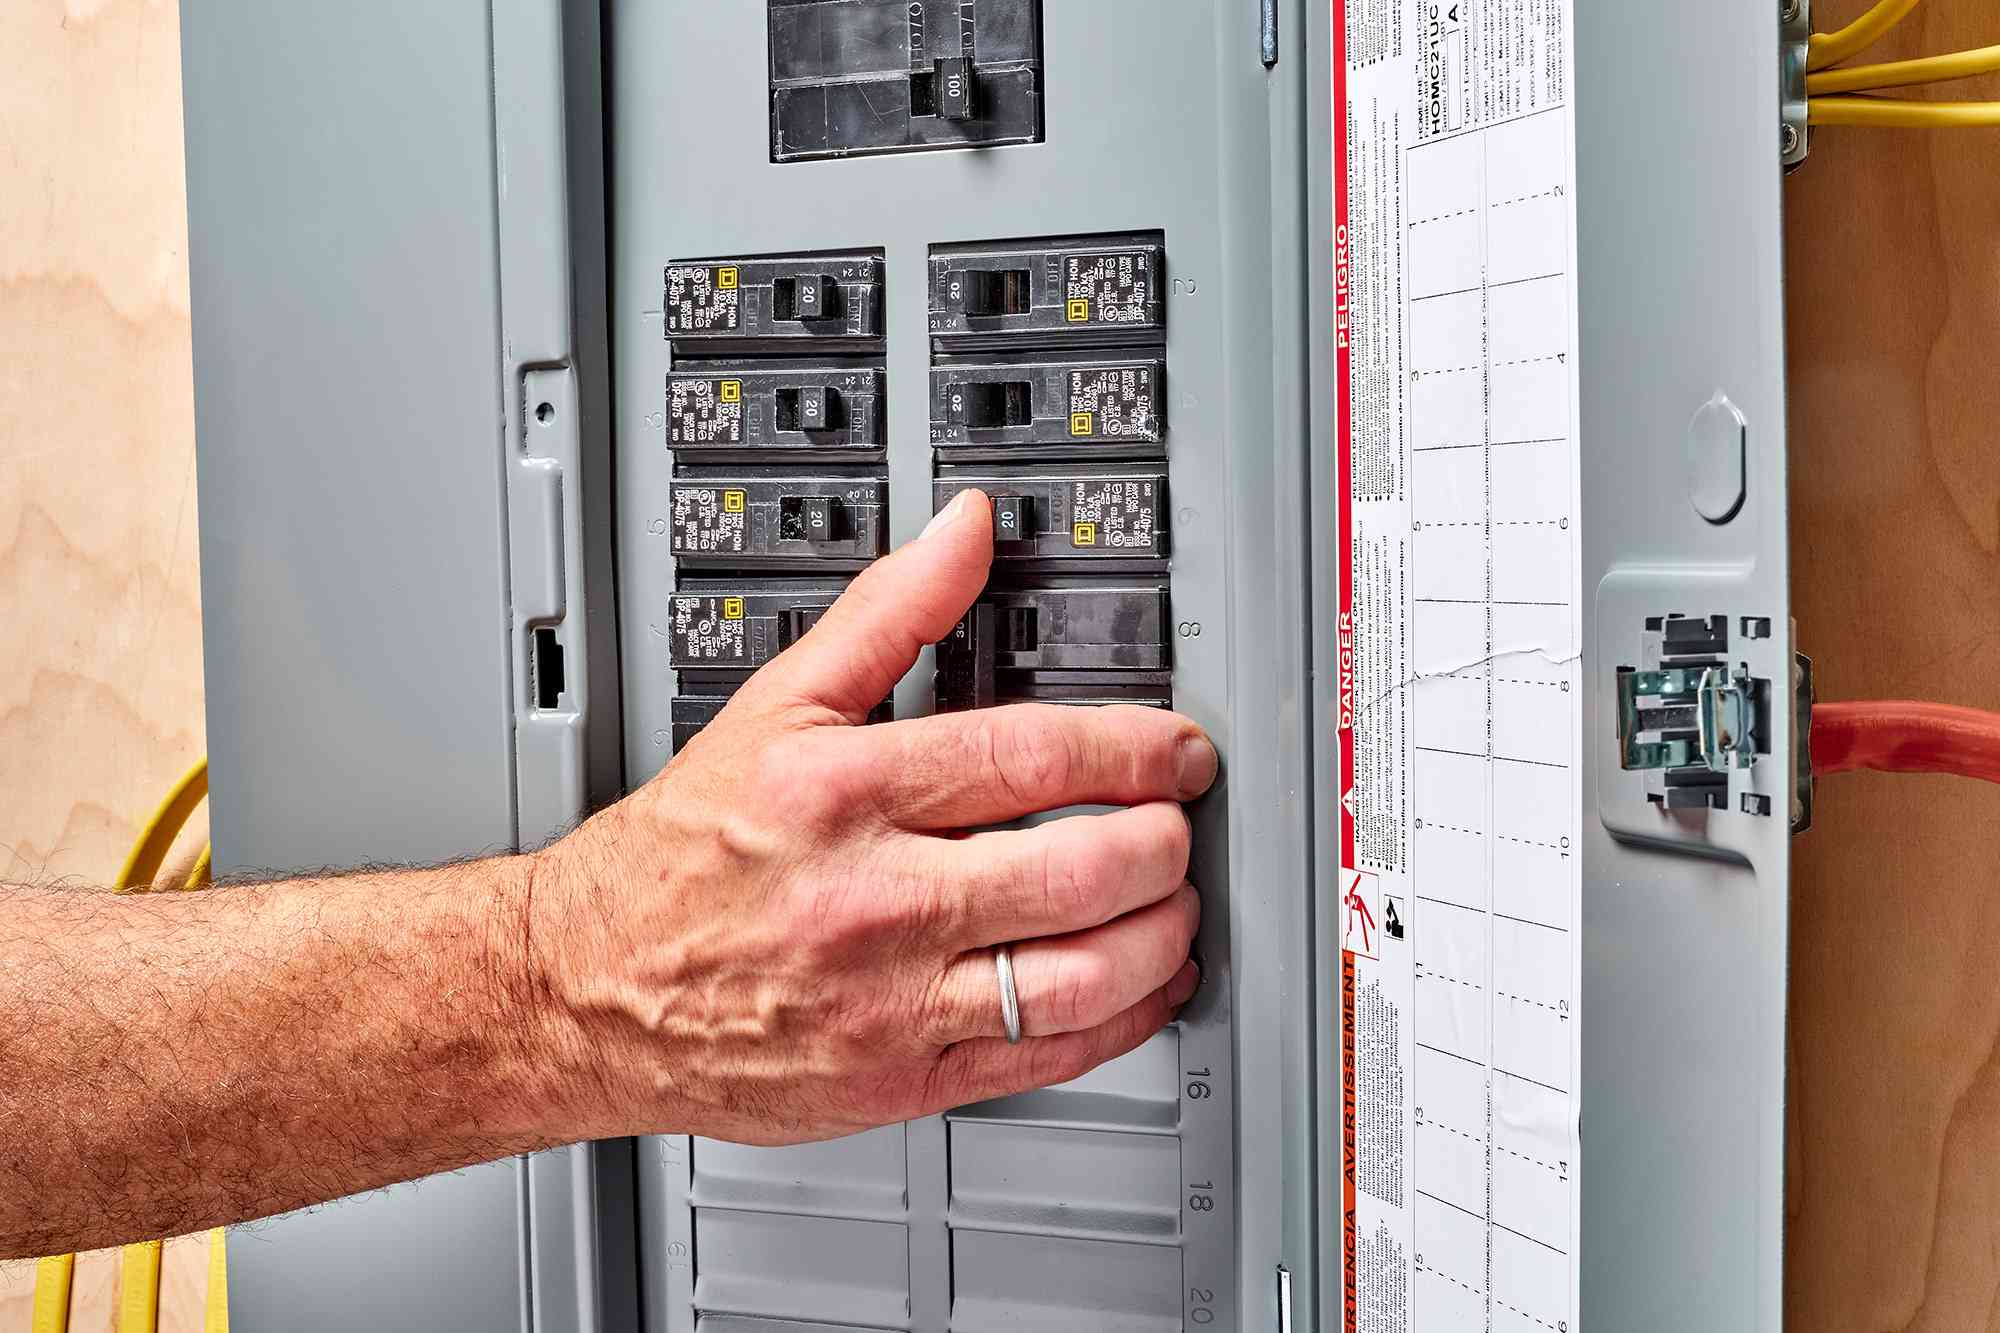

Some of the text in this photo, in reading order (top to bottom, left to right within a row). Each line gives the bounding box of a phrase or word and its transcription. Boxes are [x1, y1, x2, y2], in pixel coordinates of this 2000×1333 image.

[1448, 3, 1458, 22] A
[1430, 4, 1440, 135] HOMC21UC
[948, 73, 960, 97] 100
[1554, 184, 1563, 197] 2
[1070, 259, 1078, 281] HOM
[669, 269, 679, 306] DP-4075
[802, 286, 815, 303] 20
[950, 282, 960, 300] 20
[1081, 286, 1088, 298] 10
[1173, 278, 1197, 296] 2
[1336, 223, 1349, 349] PELIGRO
[1134, 281, 1145, 321] DP-4075
[728, 306, 736, 327] HOM
[1557, 351, 1566, 364] 4
[1073, 372, 1081, 394] HOM
[1411, 370, 1419, 382] 3
[671, 382, 682, 418] DP-4075
[805, 399, 818, 417] 20
[952, 394, 962, 412] 20
[1084, 400, 1092, 412] 10
[731, 420, 739, 441] HOM
[1076, 482, 1085, 505] HOM
[675, 490, 685, 526] DP-4075
[1087, 510, 1095, 522] 10
[811, 511, 823, 527] 20
[1001, 511, 1014, 528] 20
[1140, 508, 1151, 546] DP-4075
[1412, 520, 1421, 532] 5
[1559, 517, 1569, 529] 6
[733, 530, 742, 551] HOM
[676, 599, 686, 634] DP-4075
[955, 622, 965, 638] 30
[1178, 621, 1201, 638] 8
[734, 636, 742, 656] HOM
[1340, 610, 1352, 729] DANGER
[1560, 680, 1570, 692] 8
[1414, 817, 1422, 830] 9
[1560, 836, 1570, 861] 10
[1415, 962, 1423, 981] 11
[1559, 999, 1569, 1022] 12
[1344, 955, 1355, 1185] AVERTISSEMENT
[1186, 1066, 1211, 1100] 16
[1415, 1106, 1423, 1128] 13
[1558, 1160, 1568, 1184] 14
[1189, 1180, 1214, 1212] 18
[1415, 1253, 1423, 1272] 15
[1190, 1287, 1214, 1324] 20
